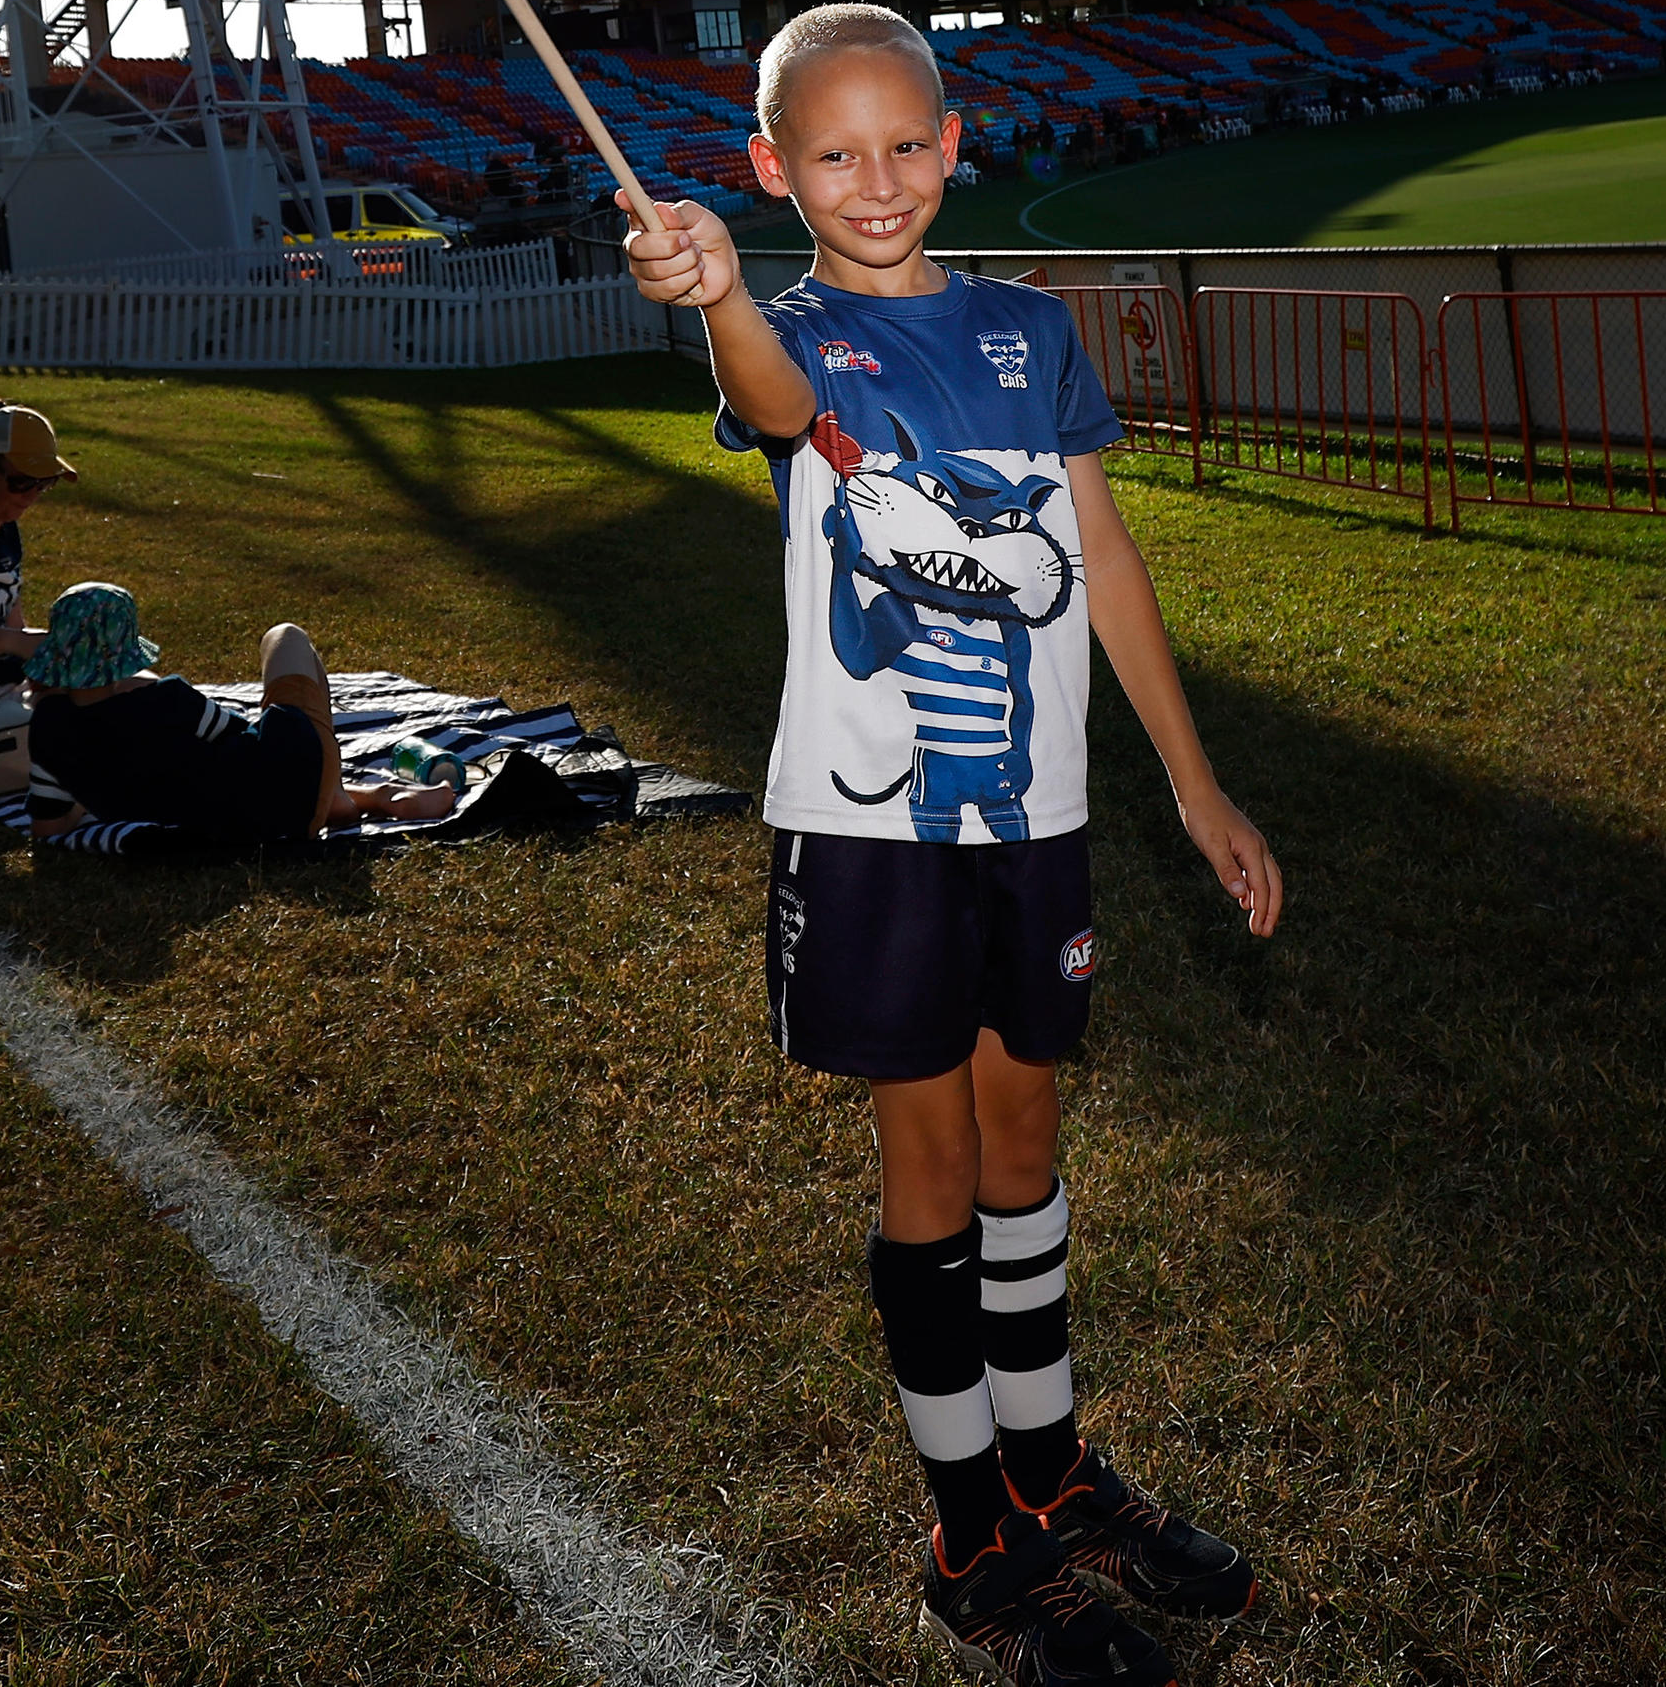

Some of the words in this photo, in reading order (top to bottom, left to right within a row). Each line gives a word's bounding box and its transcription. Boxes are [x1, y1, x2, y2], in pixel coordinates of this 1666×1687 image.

[998, 373, 1028, 389] CATS
[930, 631, 952, 646] AFL
[777, 887, 802, 910] EELONG
[1066, 938, 1093, 975] AF
